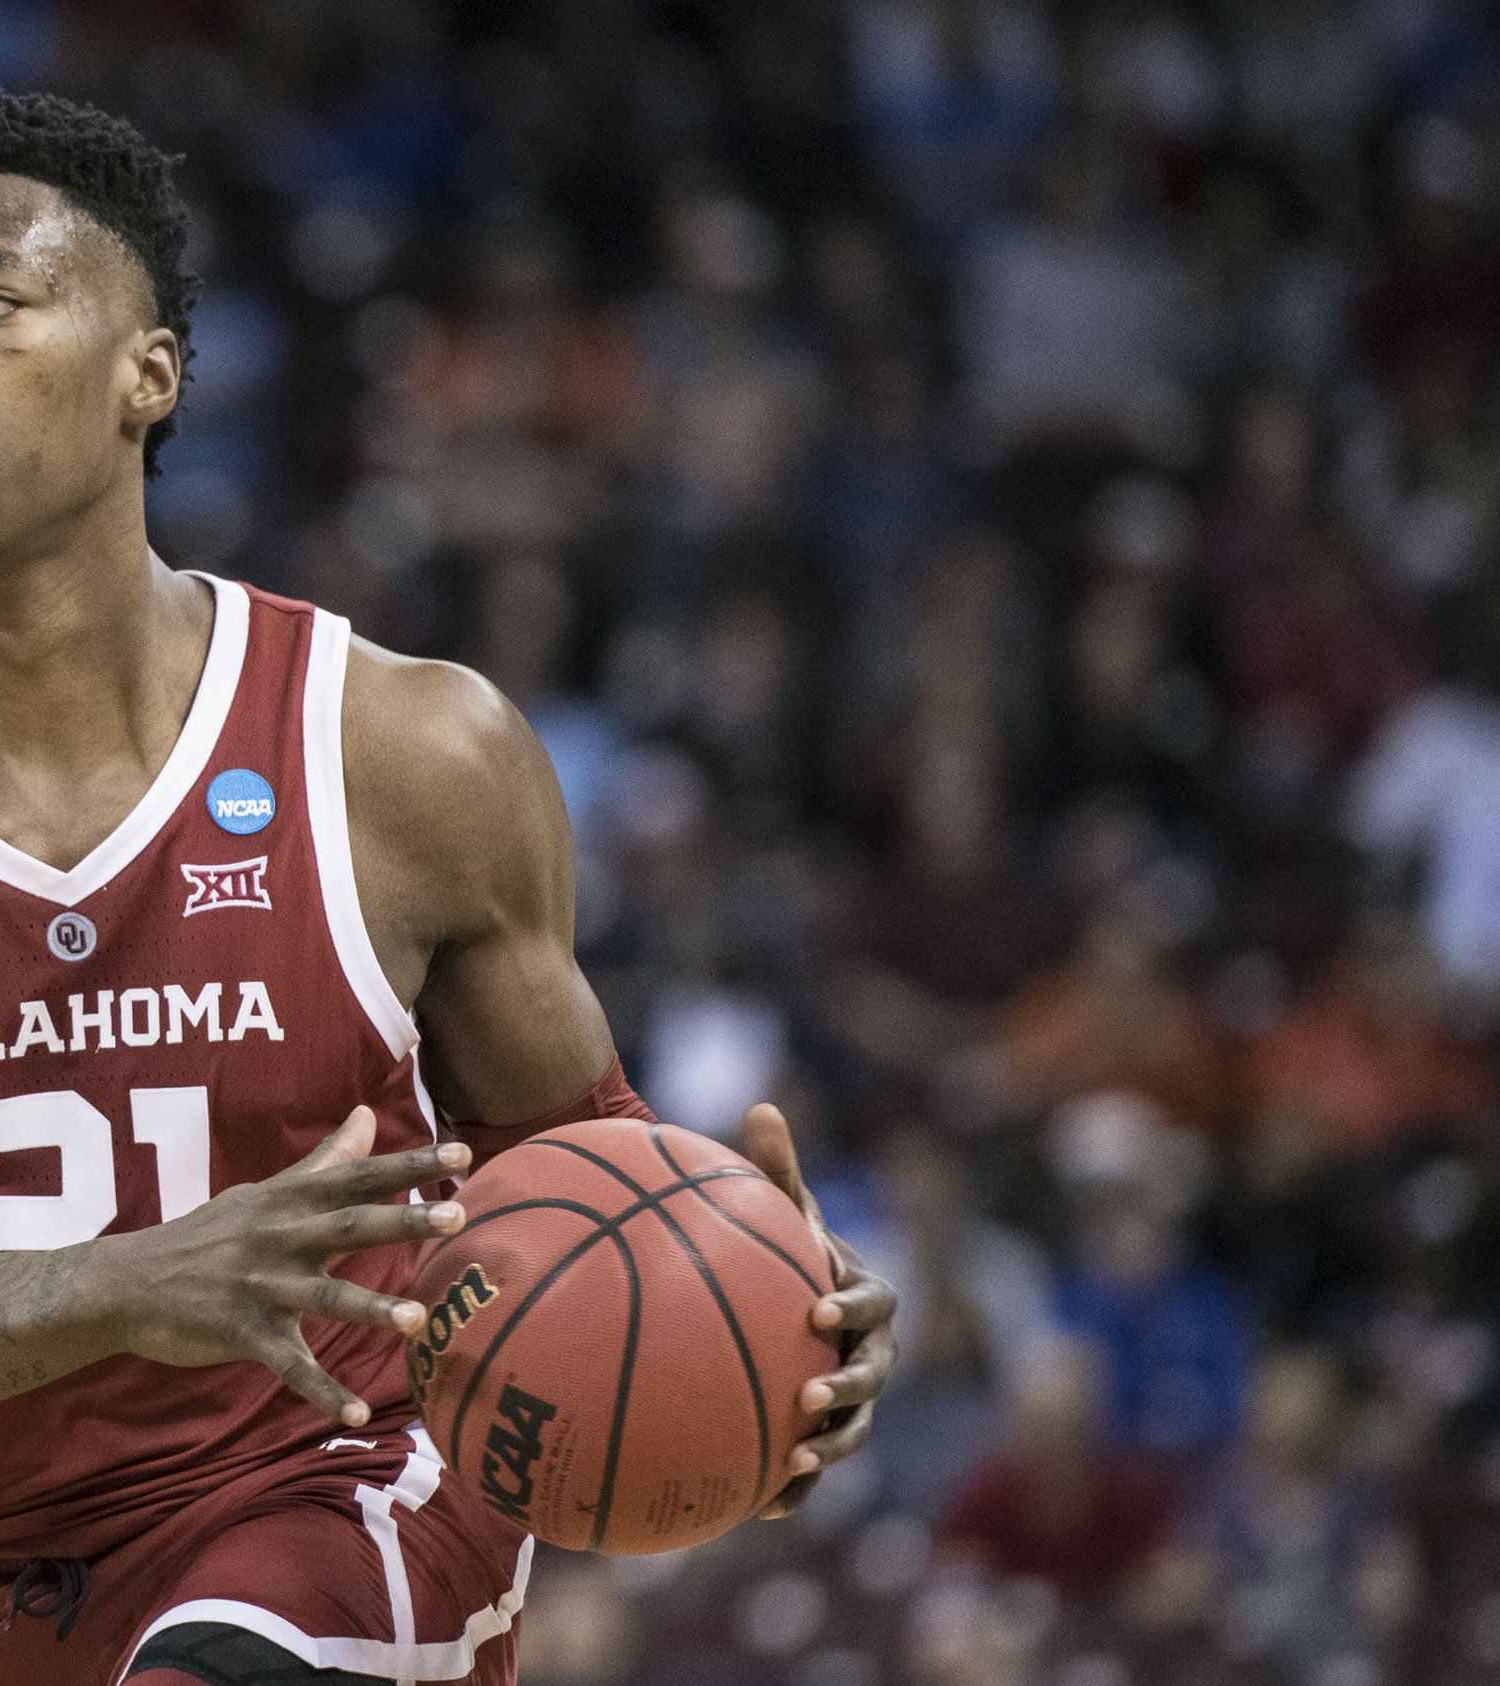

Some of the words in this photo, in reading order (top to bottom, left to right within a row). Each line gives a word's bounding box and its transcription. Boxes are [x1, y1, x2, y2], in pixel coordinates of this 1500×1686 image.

[217, 799, 272, 818] NCAA
[187, 862, 266, 911] XII
[408, 1263, 500, 1403] son
[479, 1383, 558, 1520] NCAA
